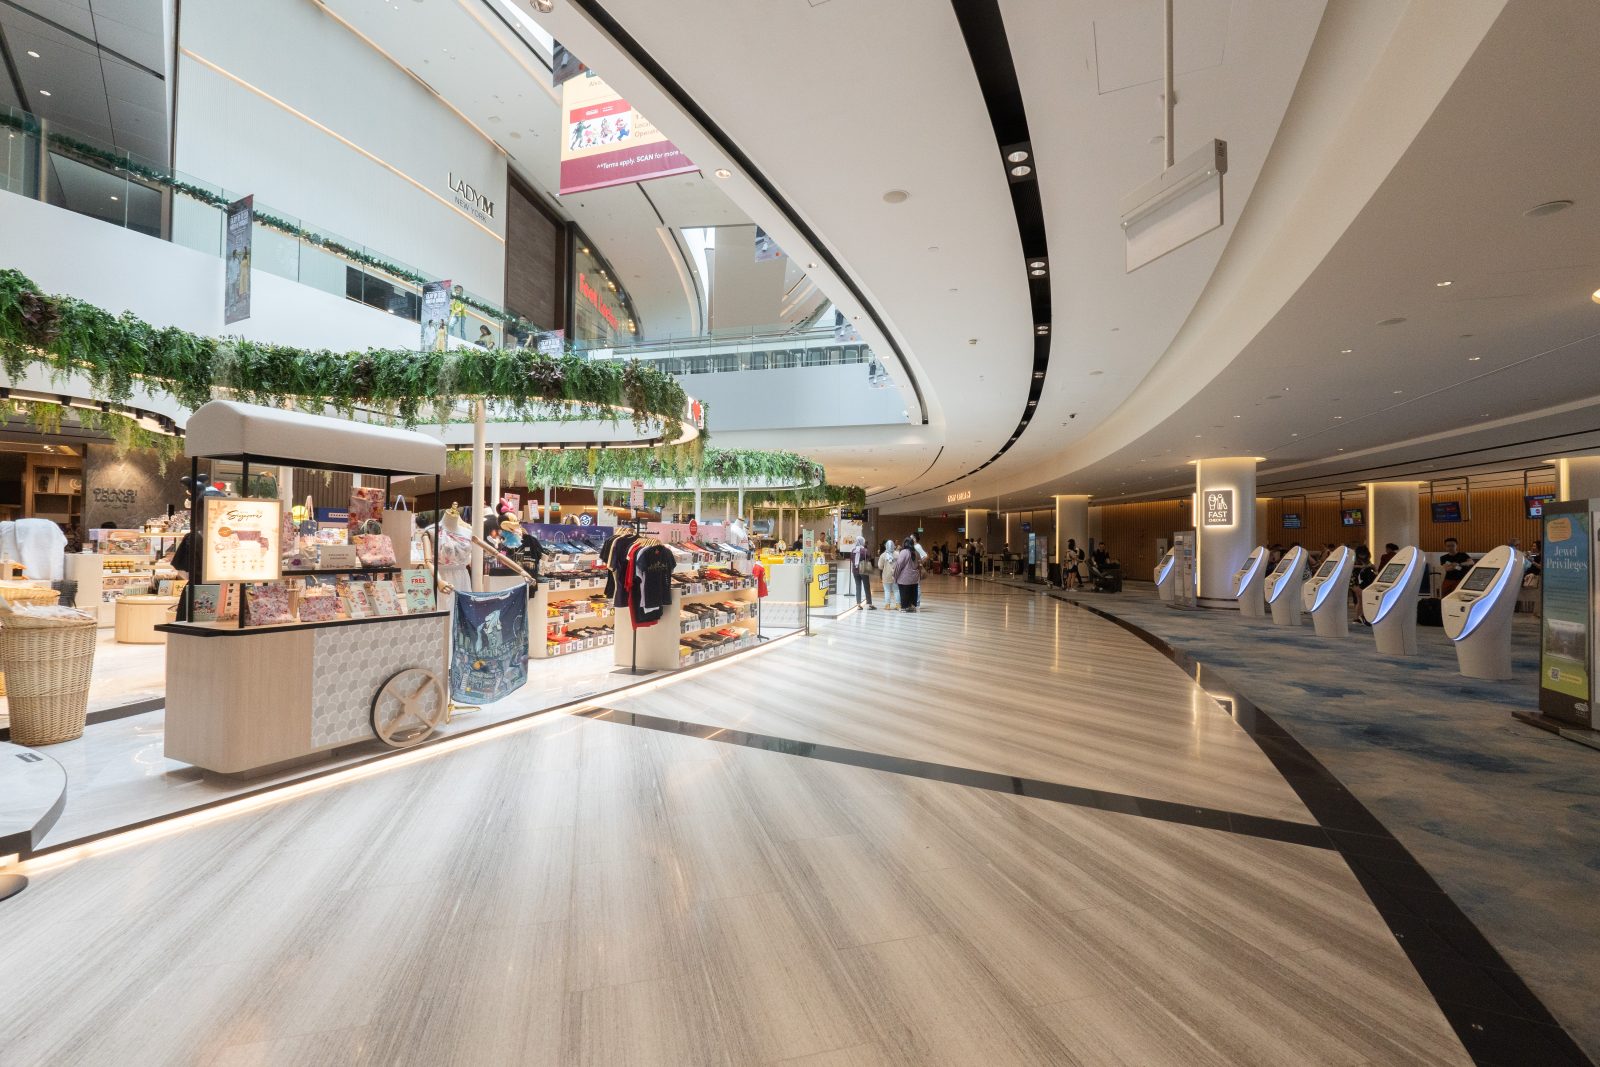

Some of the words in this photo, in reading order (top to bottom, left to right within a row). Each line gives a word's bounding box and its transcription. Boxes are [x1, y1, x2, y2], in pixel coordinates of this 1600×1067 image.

[636, 153, 654, 162] SCAN
[663, 150, 679, 158] more
[454, 196, 471, 211] NEW
[471, 206, 488, 223] YORK
[93, 488, 138, 497] CHANGI
[94, 494, 136, 504] LOUNGE
[1553, 545, 1577, 557] Jewel
[1546, 557, 1588, 573] Privileges
